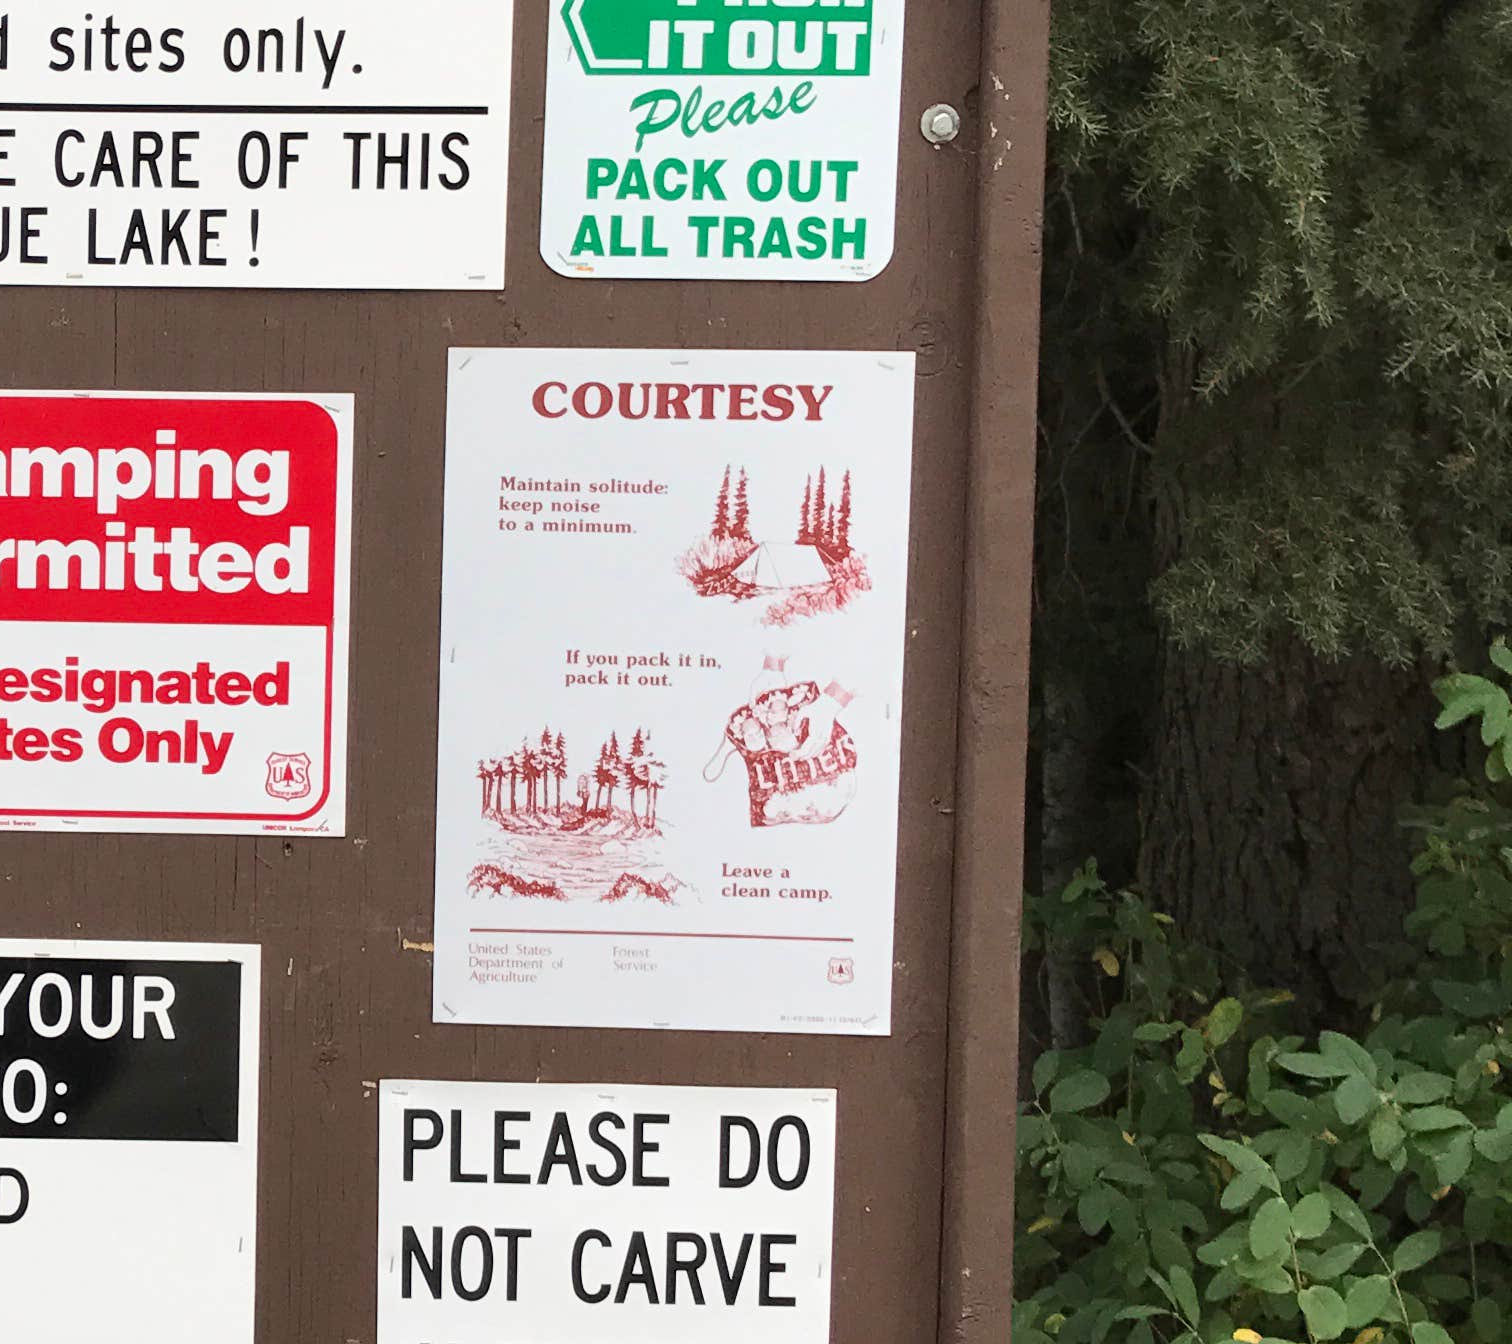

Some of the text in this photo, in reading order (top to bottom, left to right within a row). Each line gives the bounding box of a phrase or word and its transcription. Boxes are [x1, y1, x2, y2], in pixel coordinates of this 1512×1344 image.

[49, 14, 184, 72] sites
[224, 17, 362, 89] only.
[648, 20, 867, 70] IT OUT
[630, 81, 815, 152] Please
[55, 129, 199, 188] CARE
[238, 131, 308, 189] OF
[344, 132, 469, 190] THIS
[587, 158, 858, 202] PACK OUT
[571, 215, 866, 259] ALL TRASH
[533, 382, 833, 421] COURTESY
[500, 496, 600, 514] keep noise
[501, 476, 667, 494] Maintain solitude:
[499, 518, 638, 535] to a minimum.
[566, 670, 673, 688] pack it out.
[567, 650, 721, 669] If you pack it in,
[98, 717, 234, 774] Only
[723, 863, 789, 878] Leave a
[722, 883, 833, 903] clean camp.
[403, 1109, 810, 1190] PLEASE DO
[402, 1226, 796, 1307] NOT CARVE
